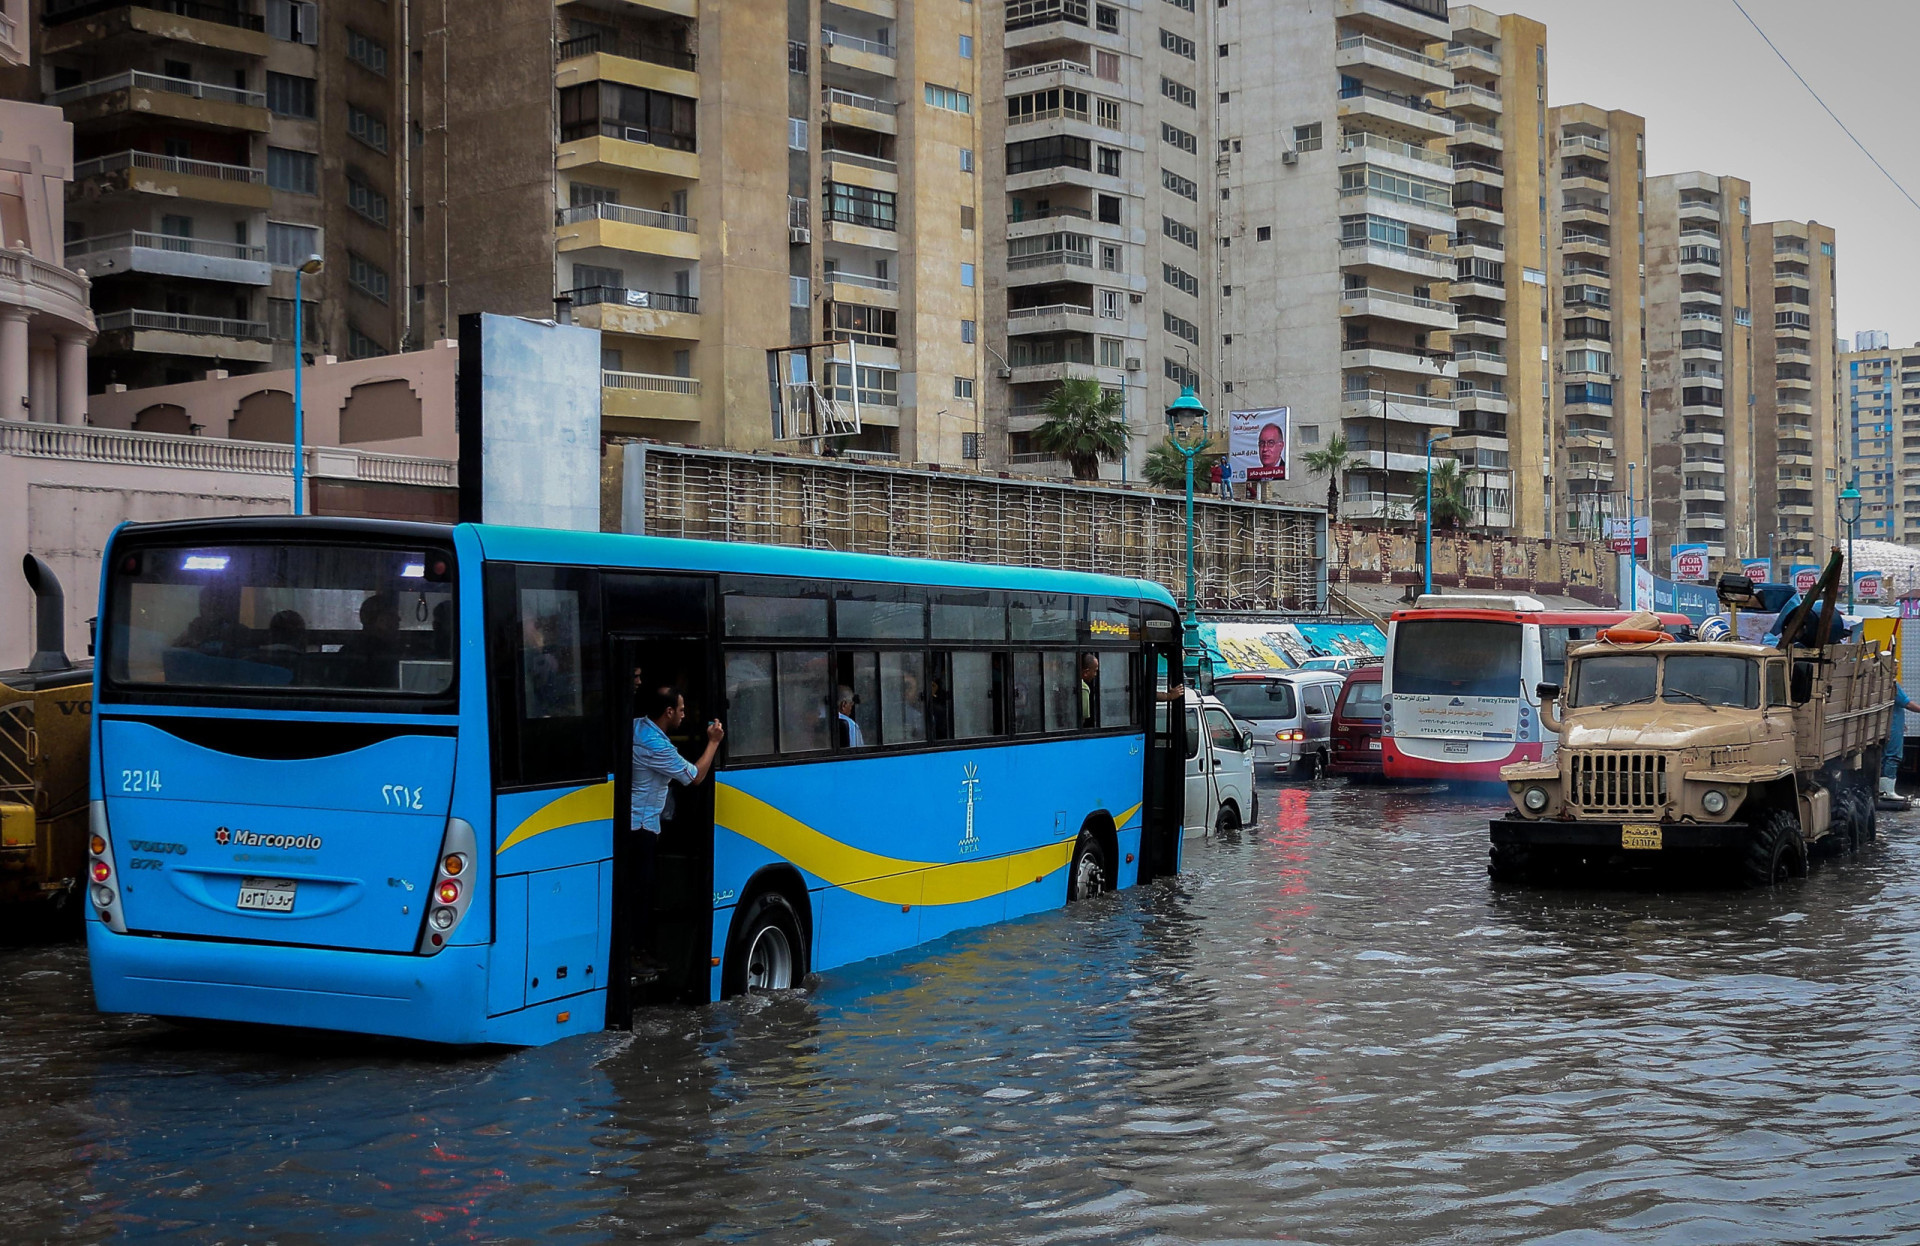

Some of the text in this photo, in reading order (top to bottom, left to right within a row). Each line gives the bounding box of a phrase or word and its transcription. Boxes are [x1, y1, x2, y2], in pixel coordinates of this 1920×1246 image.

[1747, 569, 1764, 577] FOR
[55, 700, 93, 716] VO
[122, 769, 163, 792] 2214
[382, 784, 424, 810] ٢٢١٤
[128, 839, 188, 855] VOLVO
[233, 830, 322, 849] Marcopolo
[130, 857, 164, 871] B7R
